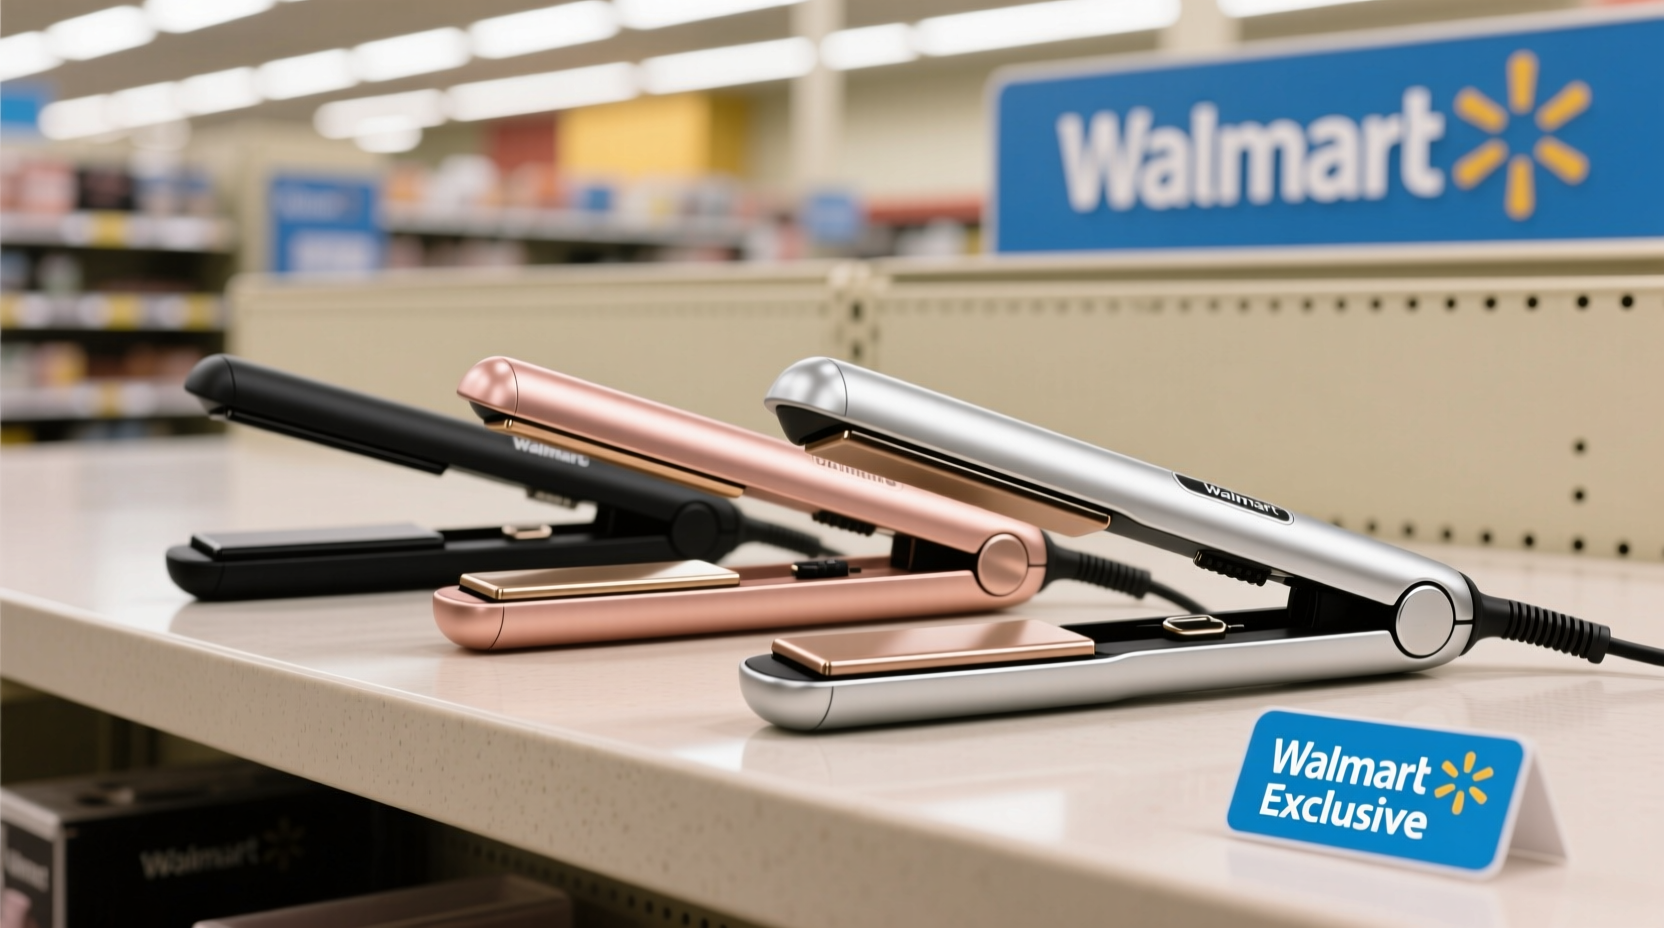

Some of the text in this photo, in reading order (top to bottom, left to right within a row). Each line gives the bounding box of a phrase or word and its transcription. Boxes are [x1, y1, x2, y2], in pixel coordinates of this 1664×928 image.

[1055, 85, 1446, 213] Walmart
[1203, 482, 1279, 516] Walmart
[1272, 737, 1432, 795] Walmart
[1259, 782, 1428, 840] Exclusive
[140, 834, 260, 880] Walmart
